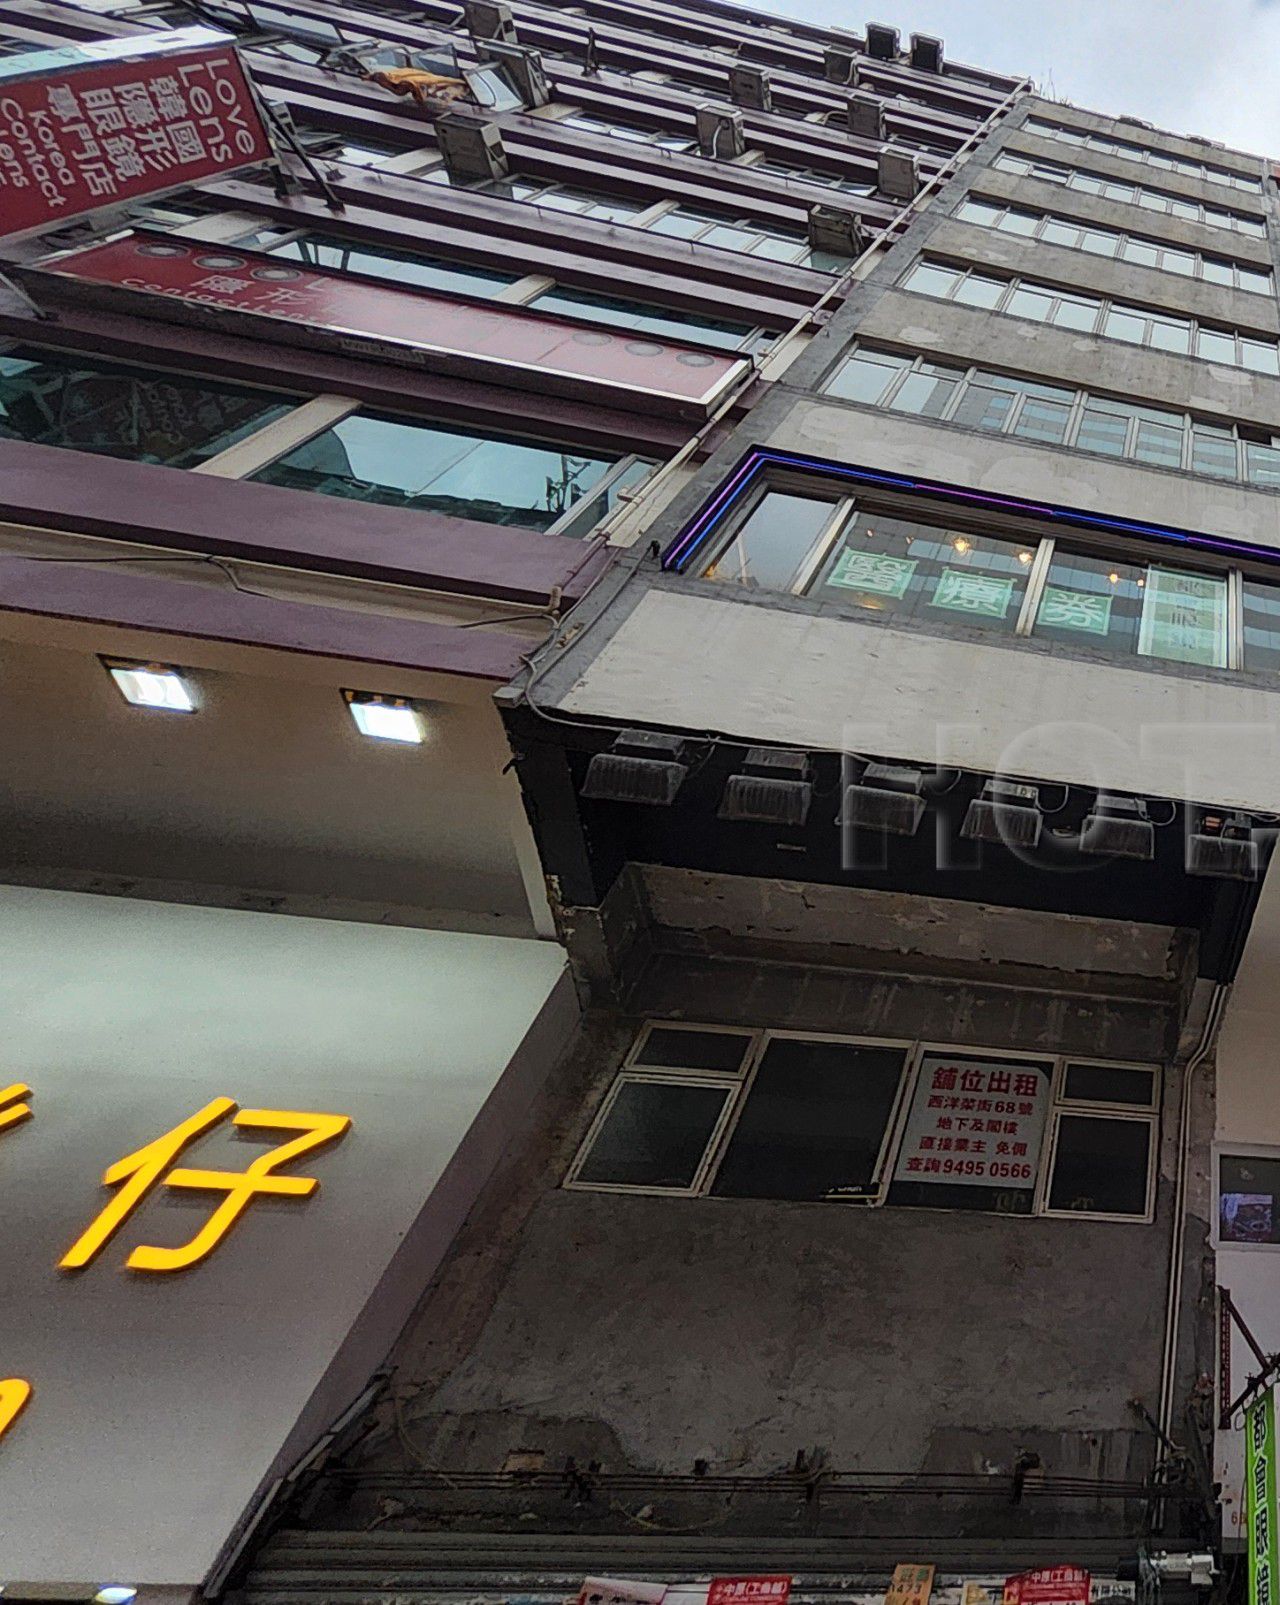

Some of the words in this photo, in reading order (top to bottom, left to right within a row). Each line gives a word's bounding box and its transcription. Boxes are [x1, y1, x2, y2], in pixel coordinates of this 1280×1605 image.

[1, 98, 67, 207] Contact
[28, 110, 76, 186] Korea
[46, 82, 118, 196] 專門店
[79, 88, 147, 182] 眼鏡
[113, 81, 180, 171] 隱形
[149, 75, 207, 164] 韓國
[177, 63, 233, 163] Lens
[205, 58, 255, 155] Love
[843, 555, 1105, 627] 醫療券
[927, 1094, 1034, 1116] 西洋菜街68號
[0, 1083, 352, 1270] 仔
[989, 1161, 1032, 1180] 0566
